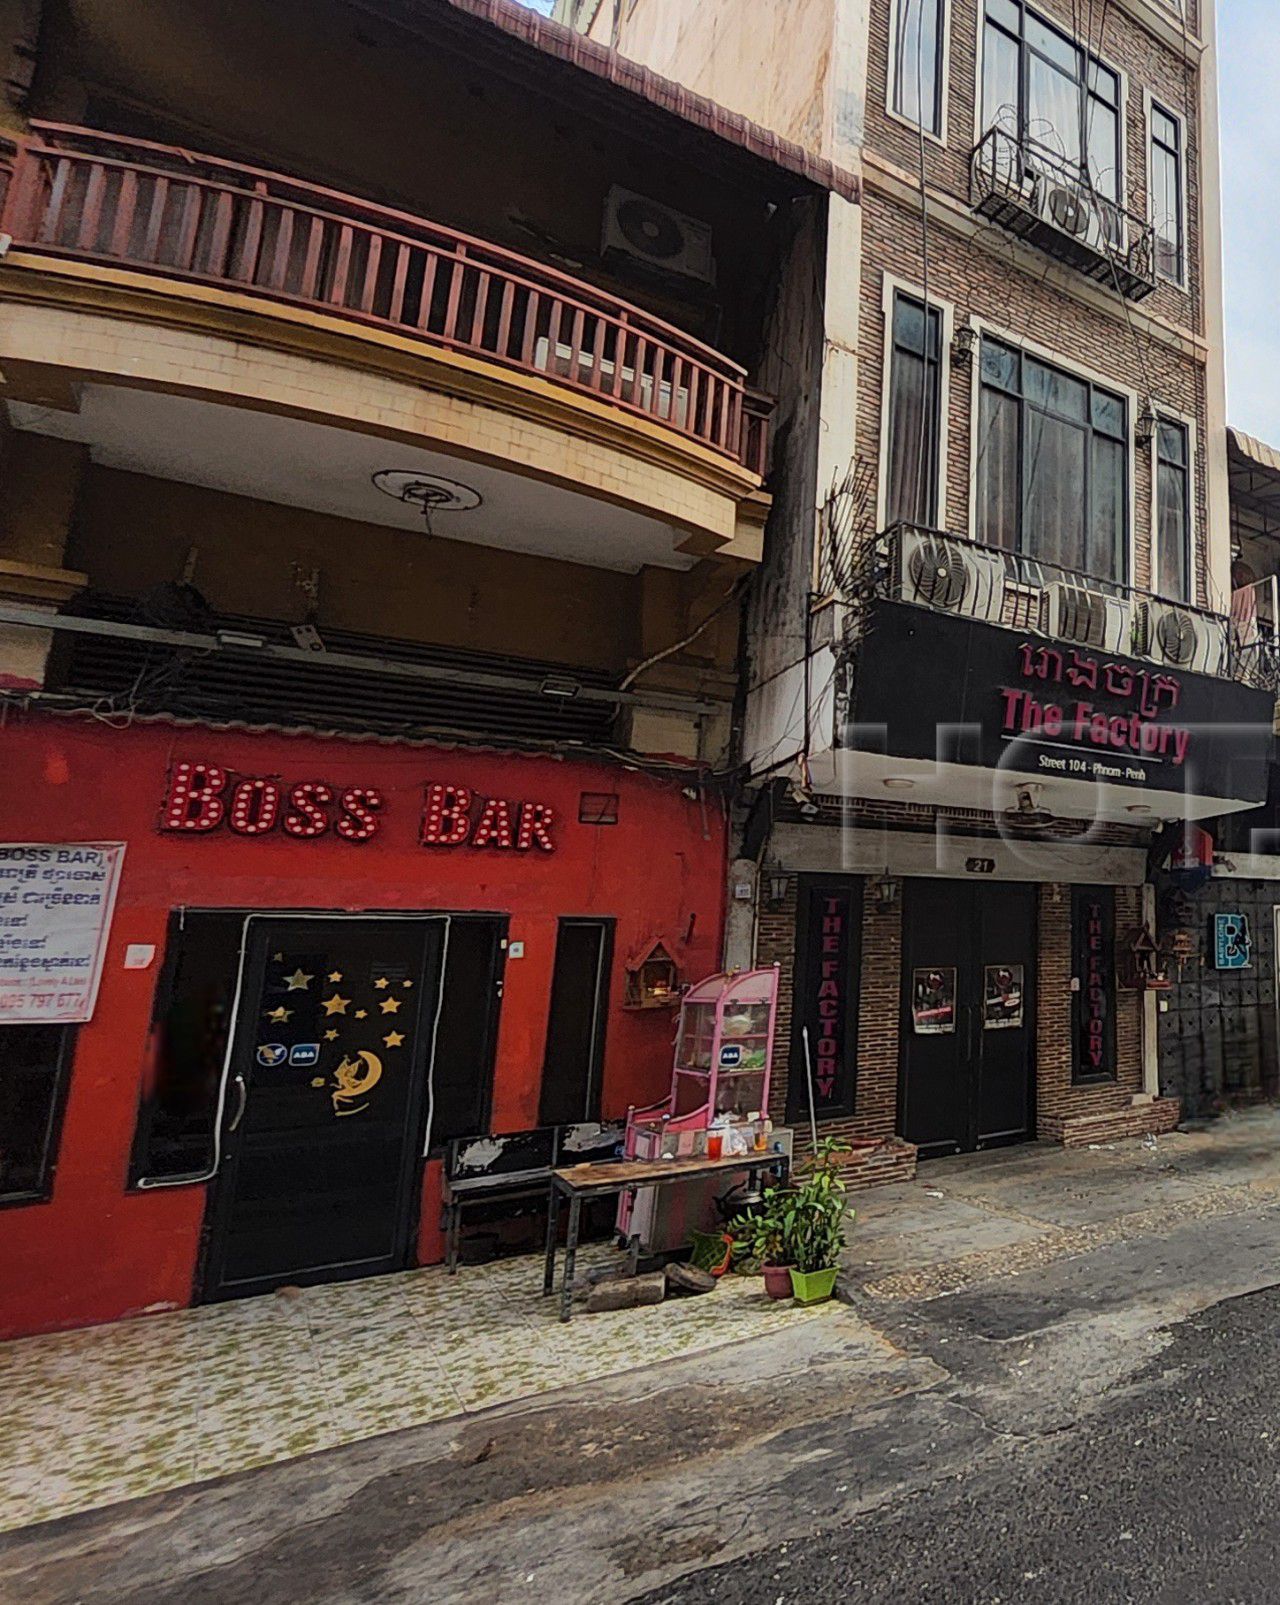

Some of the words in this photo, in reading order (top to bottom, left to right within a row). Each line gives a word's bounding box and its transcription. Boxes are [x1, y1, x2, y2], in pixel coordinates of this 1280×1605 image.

[1000, 686, 1063, 737] The
[1073, 701, 1190, 765] Factory
[1038, 754, 1066, 770] Street
[1069, 759, 1087, 773] 104
[1093, 762, 1121, 777] Phnom
[1125, 767, 1146, 781] Penh
[973, 860, 989, 872] 21
[823, 898, 842, 953] THE
[1088, 904, 1102, 950] THE
[816, 961, 840, 1097] FACTORY
